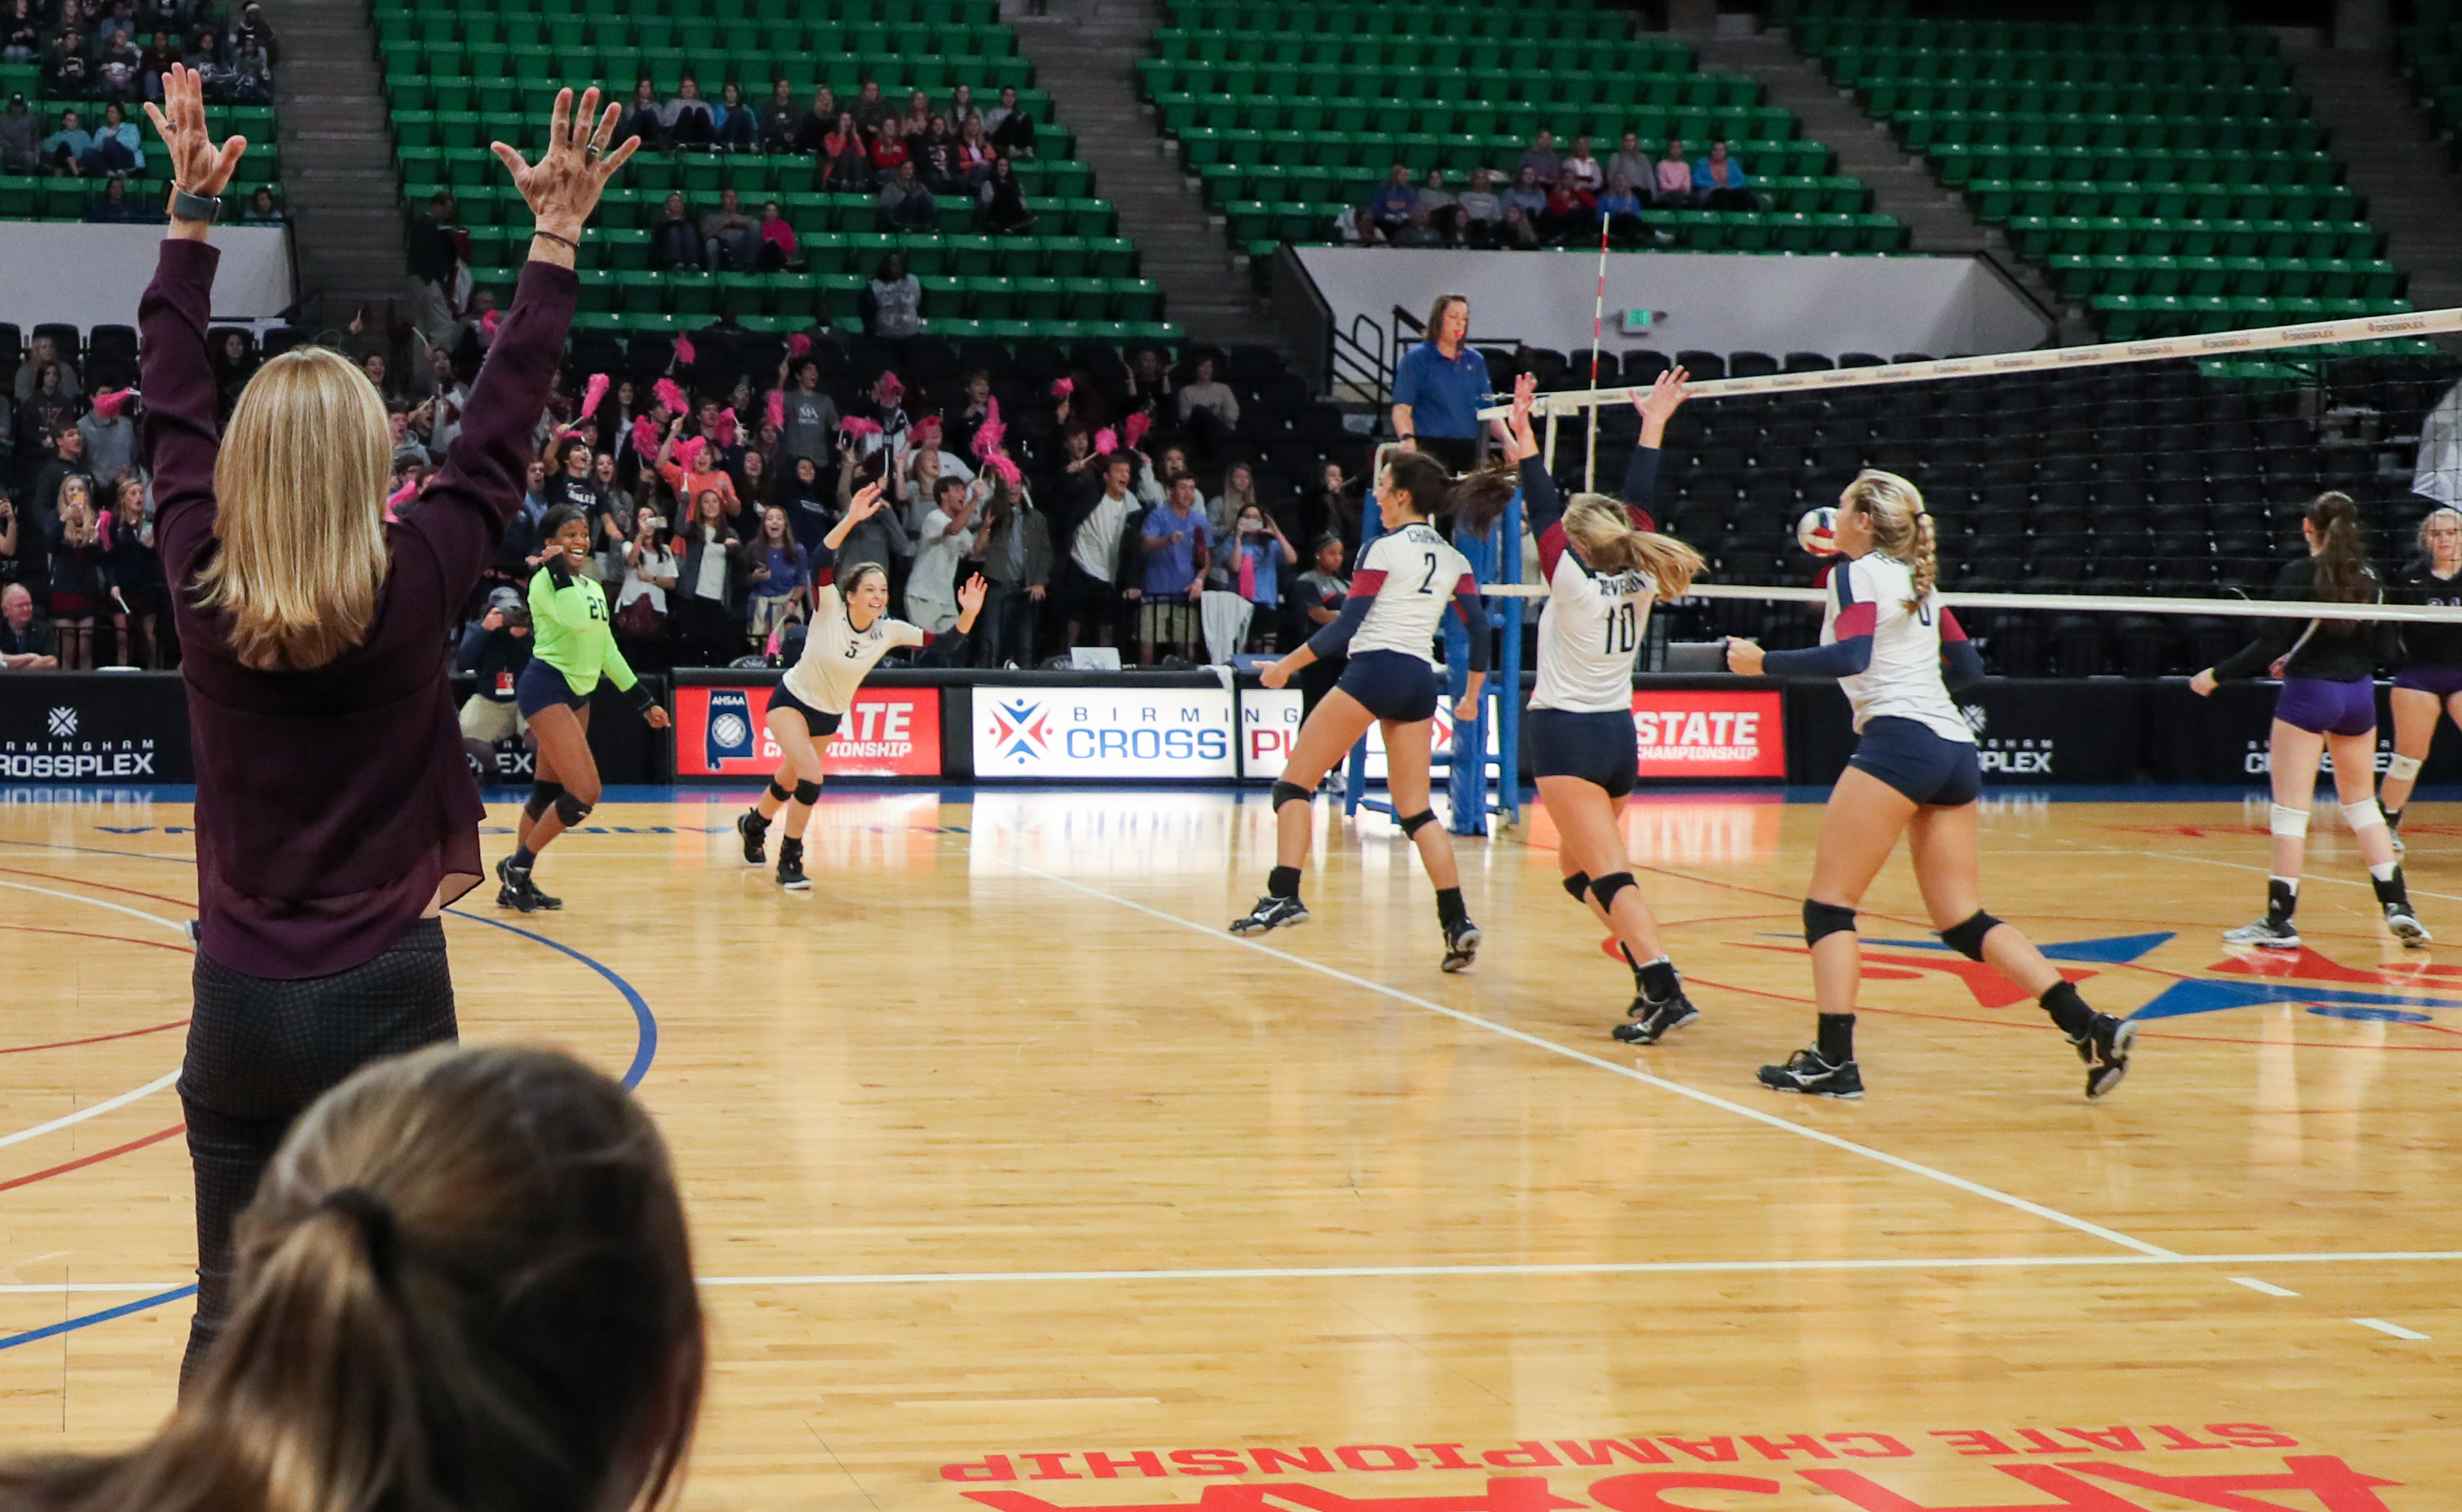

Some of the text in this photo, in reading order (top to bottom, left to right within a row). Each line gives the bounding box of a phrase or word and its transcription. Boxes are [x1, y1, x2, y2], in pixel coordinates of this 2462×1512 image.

[1418, 552, 1436, 594] 2
[586, 595, 610, 621] 20
[1605, 602, 1636, 654] 10
[845, 640, 859, 659] 5
[711, 695, 746, 705] AHSAA
[1074, 707, 1298, 723] BIRMING
[1632, 711, 1760, 746] STATE
[5, 739, 154, 752] RMINGHAM
[762, 741, 913, 759] CIONSHIP
[0, 753, 154, 777] ROSSPLEX
[939, 1422, 2299, 1482] STATE CHAMPIONSHIP
